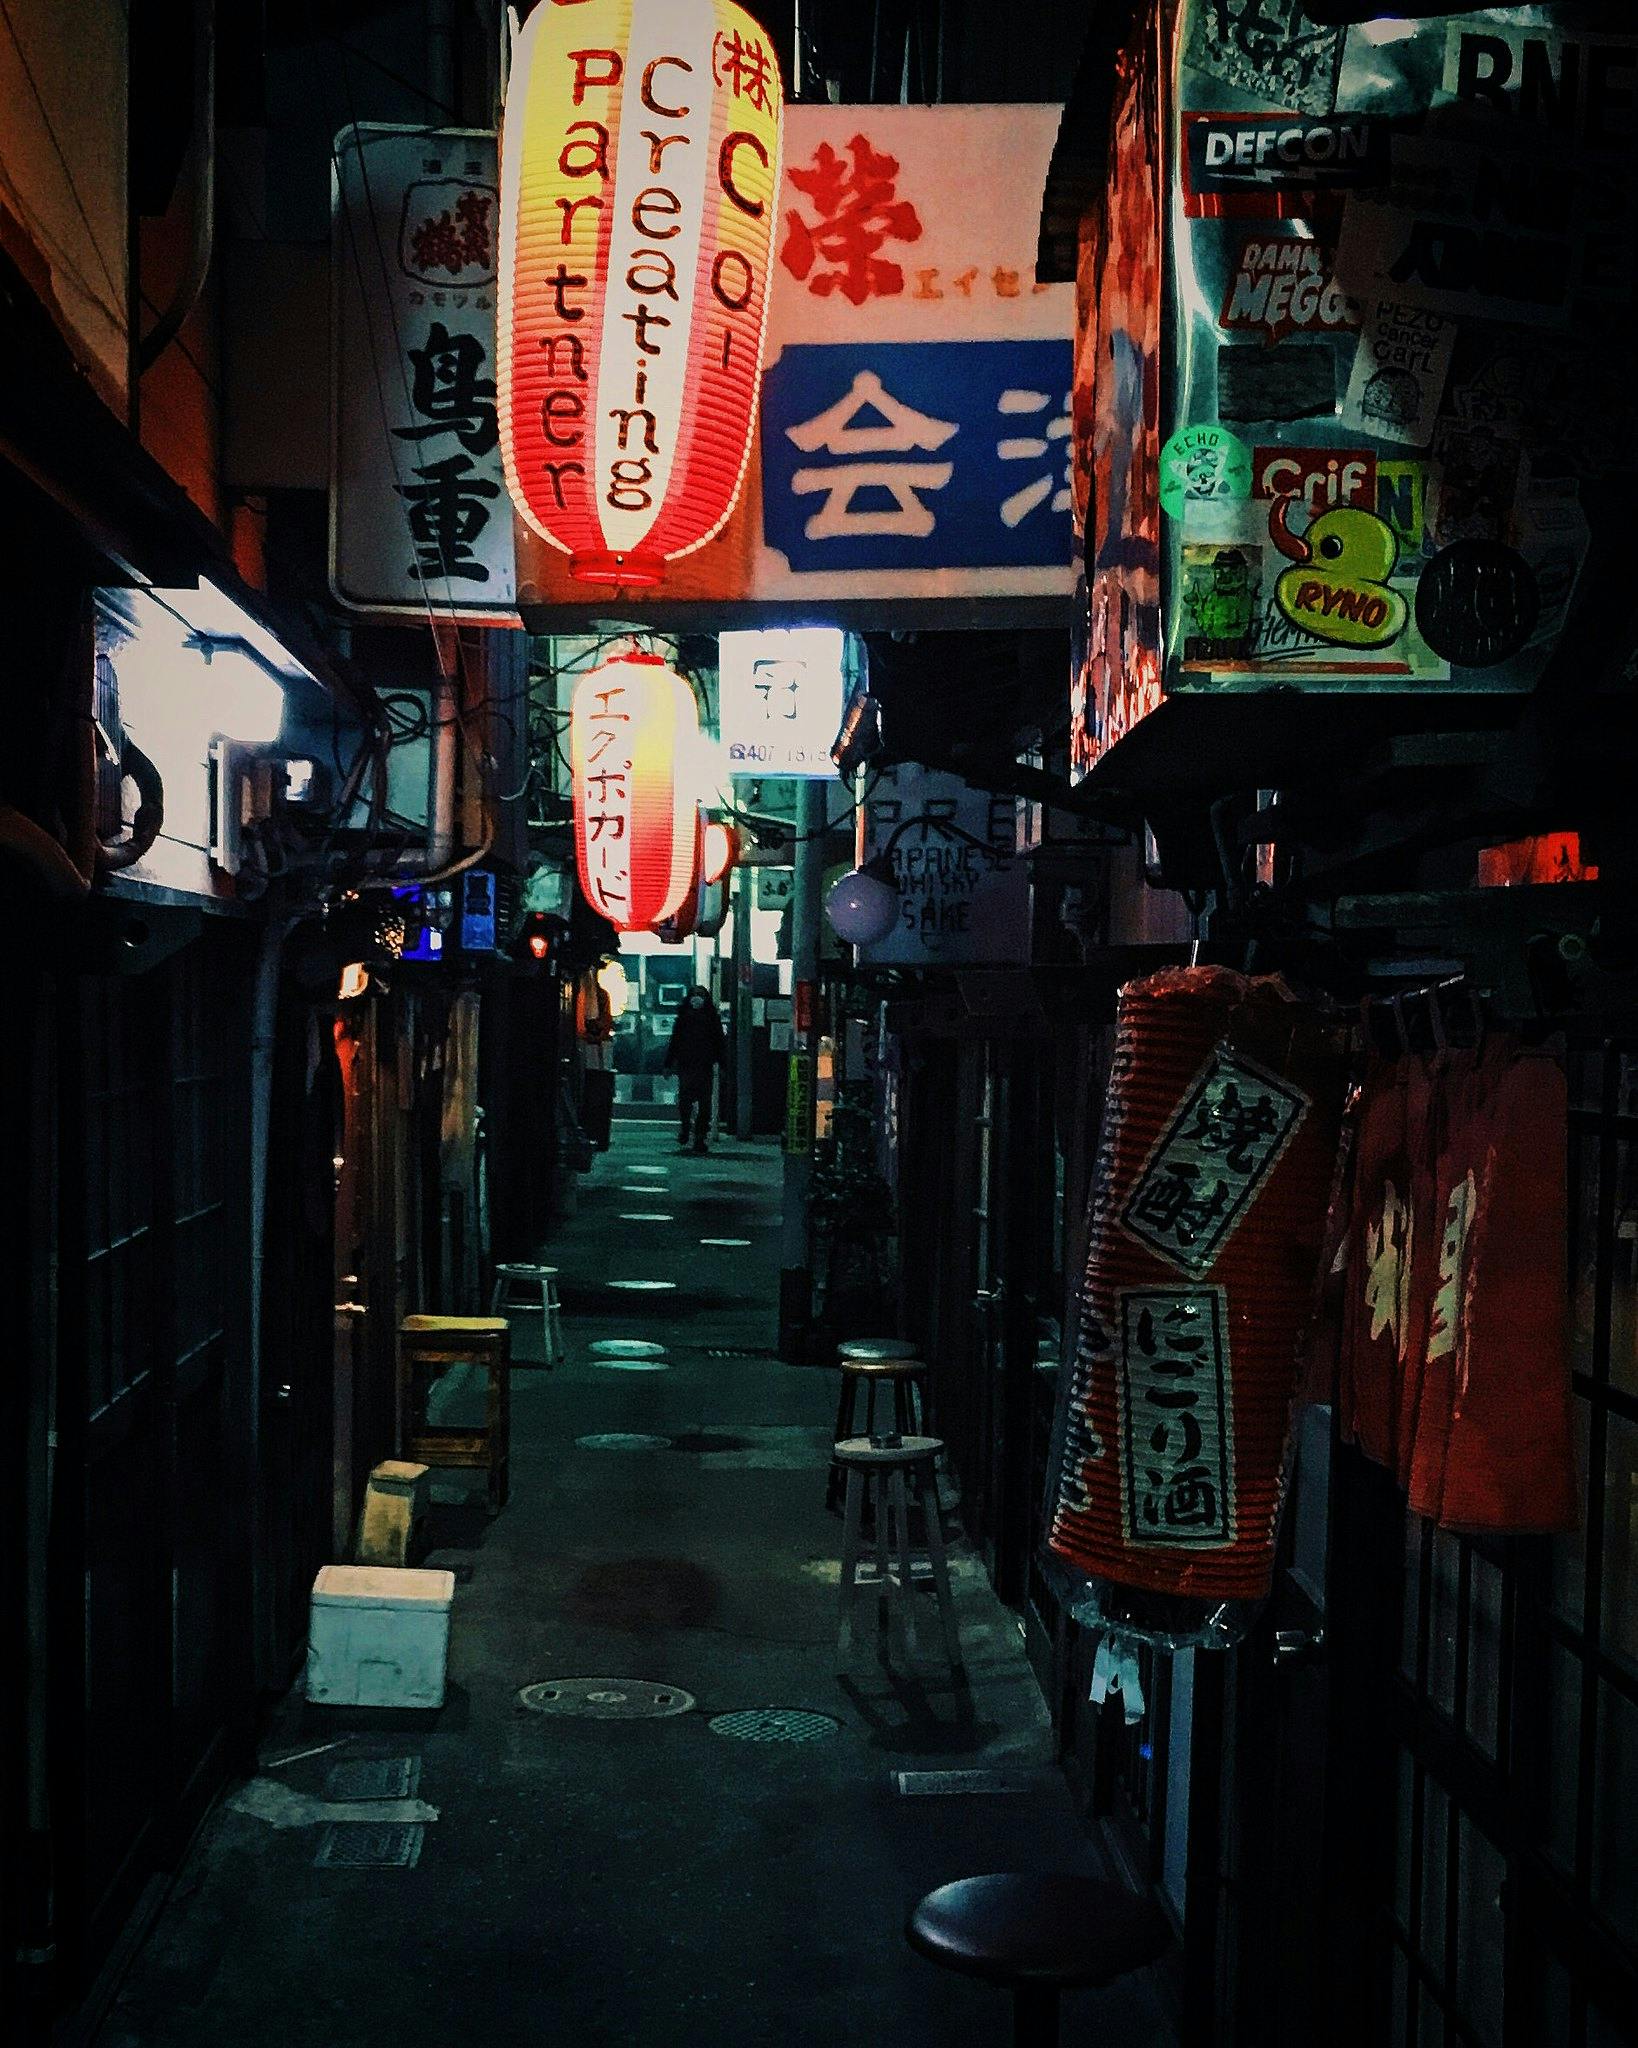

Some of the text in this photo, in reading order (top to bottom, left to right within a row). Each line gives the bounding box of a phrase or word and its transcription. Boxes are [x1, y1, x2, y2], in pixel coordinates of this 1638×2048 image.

[1205, 126, 1371, 166] DEFCON
[538, 49, 624, 510] Partner
[606, 56, 693, 510] Creating
[391, 322, 500, 582] 鳥重
[1173, 432, 1219, 455] ECHO
[1295, 580, 1388, 629] RYNO
[902, 897, 971, 932] SAKE
[1137, 1306, 1217, 1525] にごり酒
